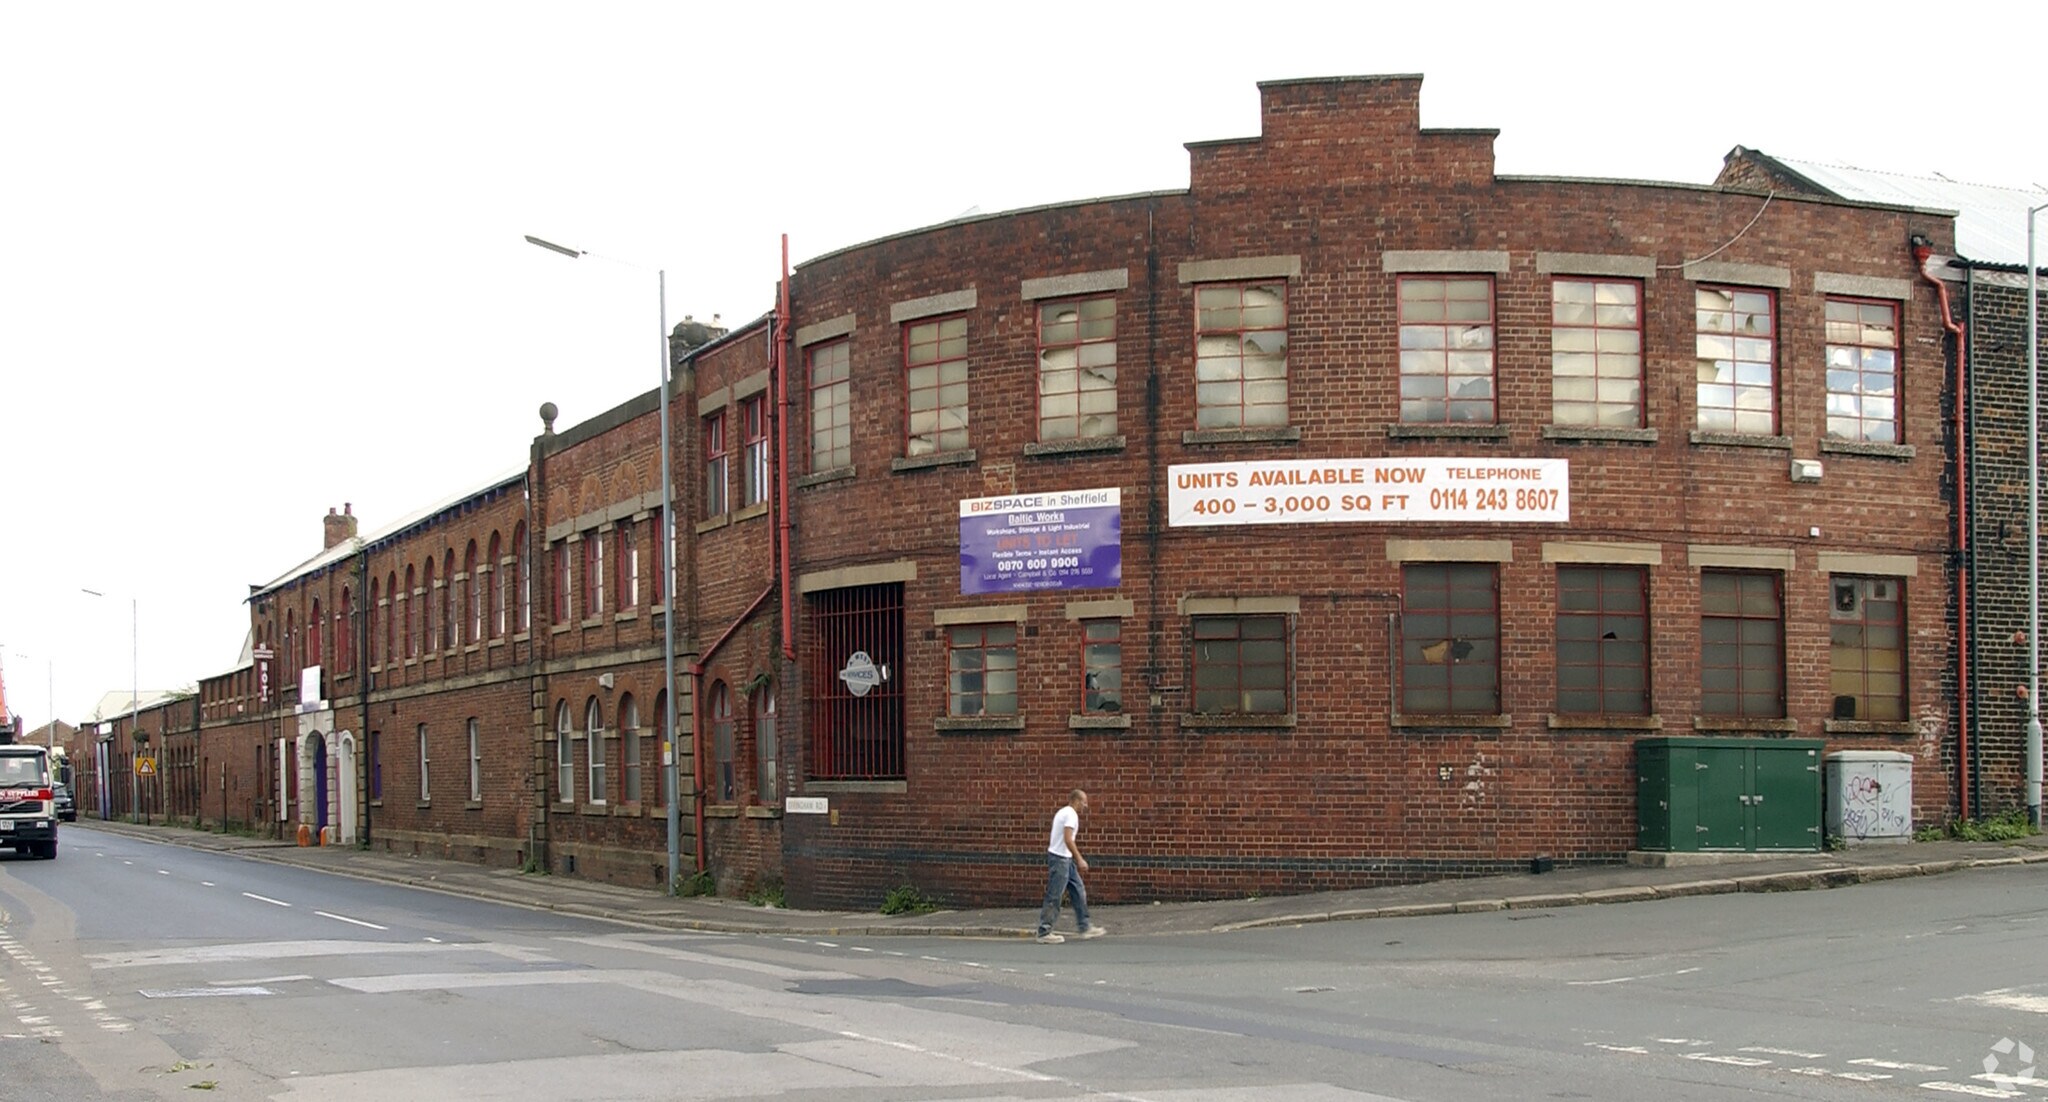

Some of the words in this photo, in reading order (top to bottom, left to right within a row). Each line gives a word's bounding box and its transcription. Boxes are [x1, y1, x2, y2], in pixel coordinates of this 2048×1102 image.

[1177, 471, 1239, 489] UNITS
[1249, 468, 1364, 487] AVAILABLE
[1375, 467, 1426, 484] NOW
[1446, 467, 1542, 480] TELEPHONE
[971, 497, 1043, 512] BIZSPACE
[1047, 497, 1056, 506] in
[1060, 492, 1108, 506] Sheffield
[1193, 498, 1236, 515] 400
[1264, 496, 1331, 516] 3,000
[1341, 494, 1372, 511] SQ
[1382, 494, 1409, 510] FT
[1430, 488, 1468, 510] 0114
[1475, 488, 1508, 510] 243
[1516, 488, 1559, 511] 8607
[1008, 513, 1034, 525] Baltic
[1036, 511, 1065, 523] Works
[1048, 524, 1062, 533] Light
[1060, 547, 1082, 555] Access
[997, 560, 1024, 572] 0870
[1027, 558, 1047, 570] 609
[1051, 556, 1079, 569] 9906
